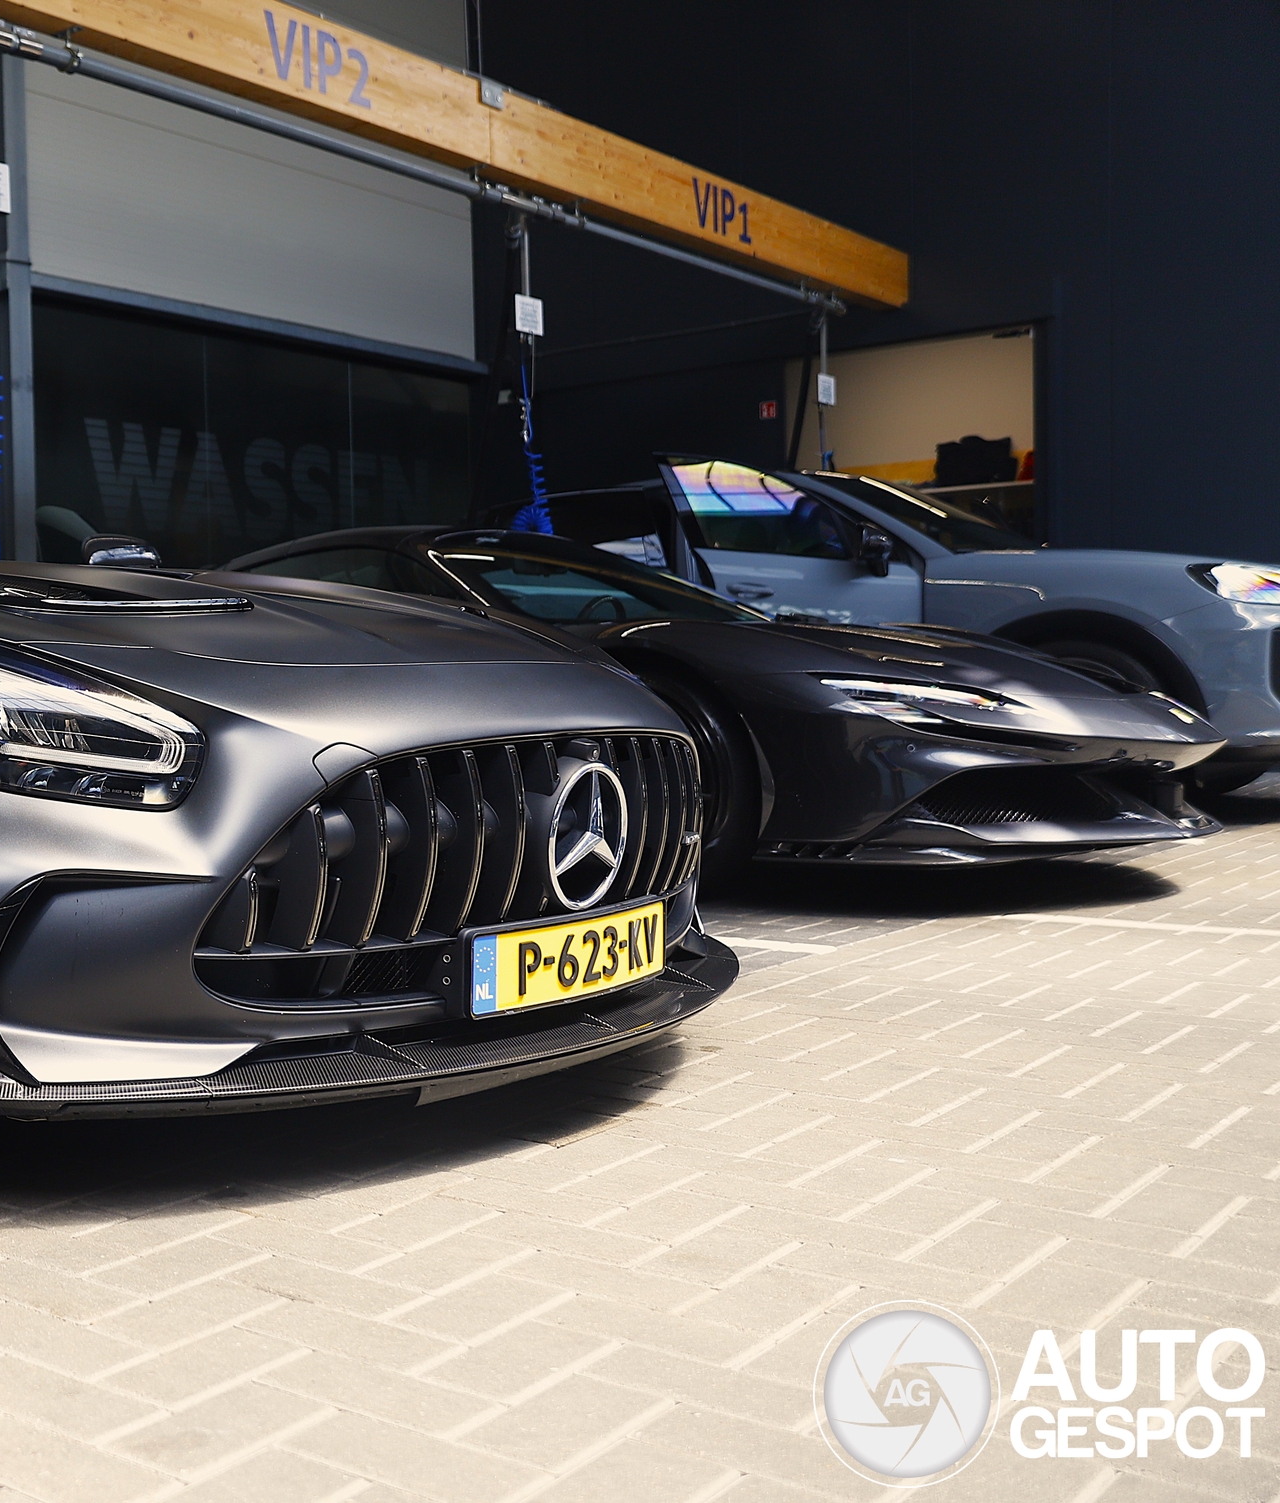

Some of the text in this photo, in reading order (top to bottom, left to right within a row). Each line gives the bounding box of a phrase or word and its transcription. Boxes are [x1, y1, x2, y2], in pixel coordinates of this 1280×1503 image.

[263, 9, 371, 109] VIP2
[692, 176, 752, 244] VIP1
[83, 416, 431, 538] WASSEN
[475, 983, 494, 1002] NL
[518, 913, 658, 997] P-623-KV
